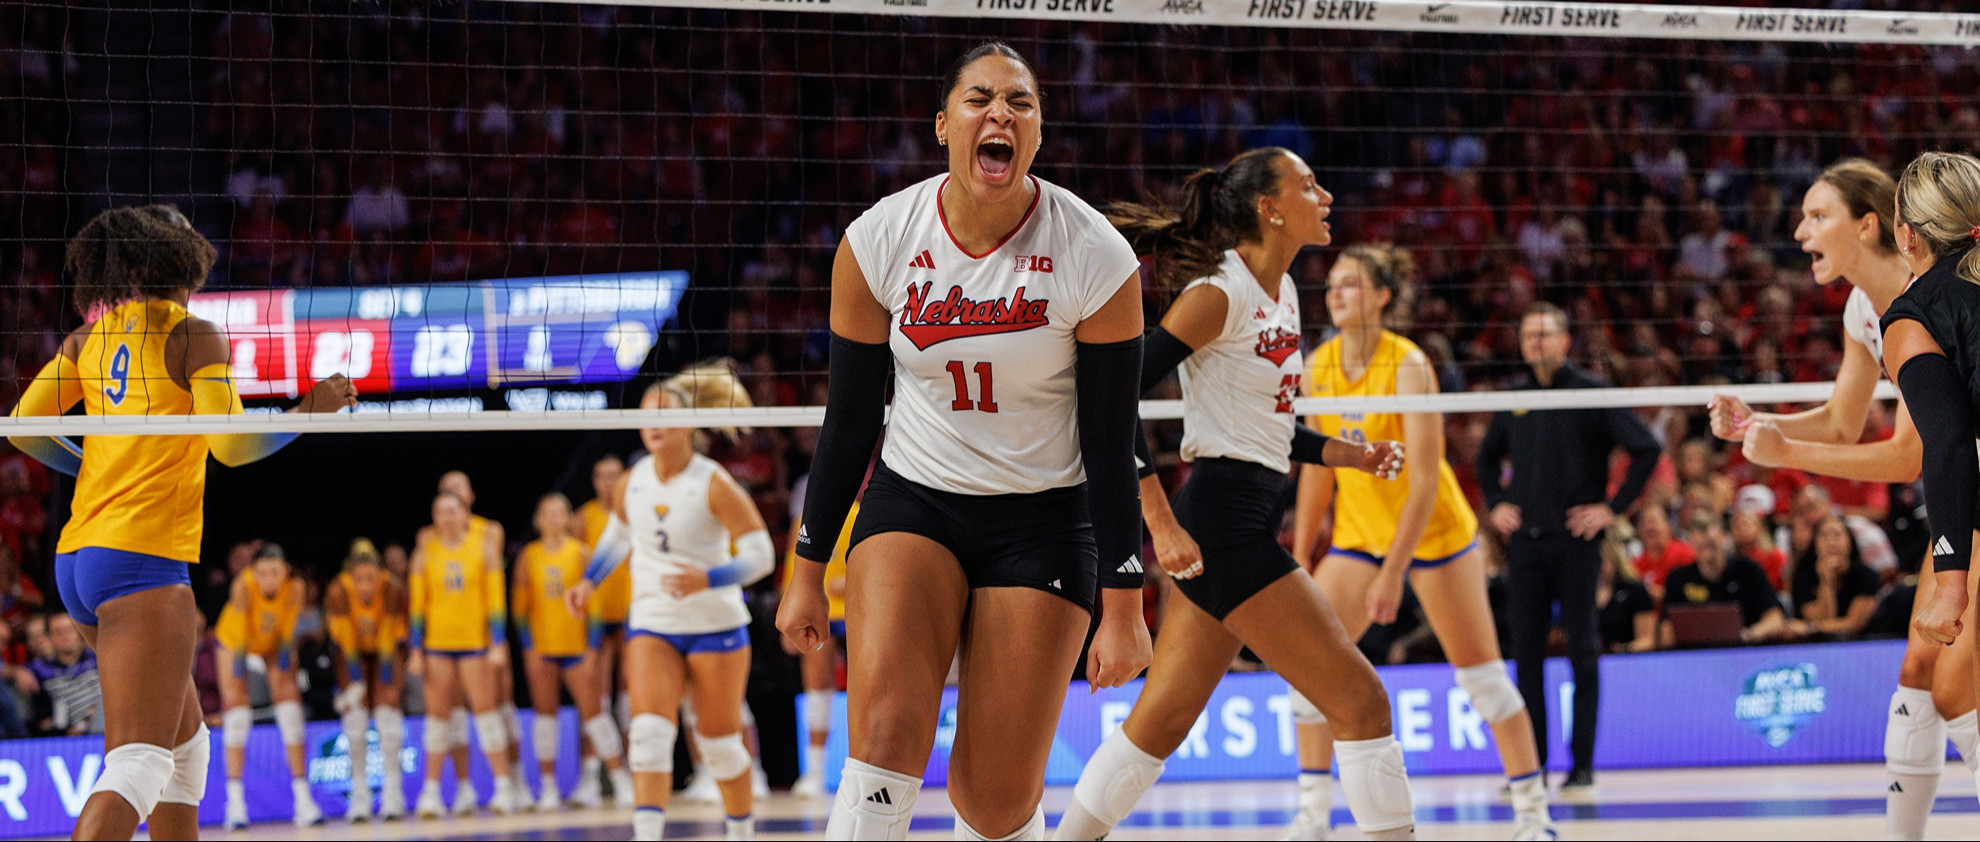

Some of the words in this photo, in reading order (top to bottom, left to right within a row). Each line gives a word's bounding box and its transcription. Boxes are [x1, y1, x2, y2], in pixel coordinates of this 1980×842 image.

[1247, 0, 1307, 20] FIRST
[1313, 0, 1378, 21] SERVE
[1500, 7, 1556, 27] FIRST
[1561, 8, 1621, 28] SERVE
[1735, 14, 1787, 32] FIRST
[1792, 15, 1848, 33] SERVE
[899, 280, 1050, 326] Nebraska
[105, 342, 131, 408] 9
[945, 360, 998, 413] 11
[1100, 694, 1297, 760] FRST
